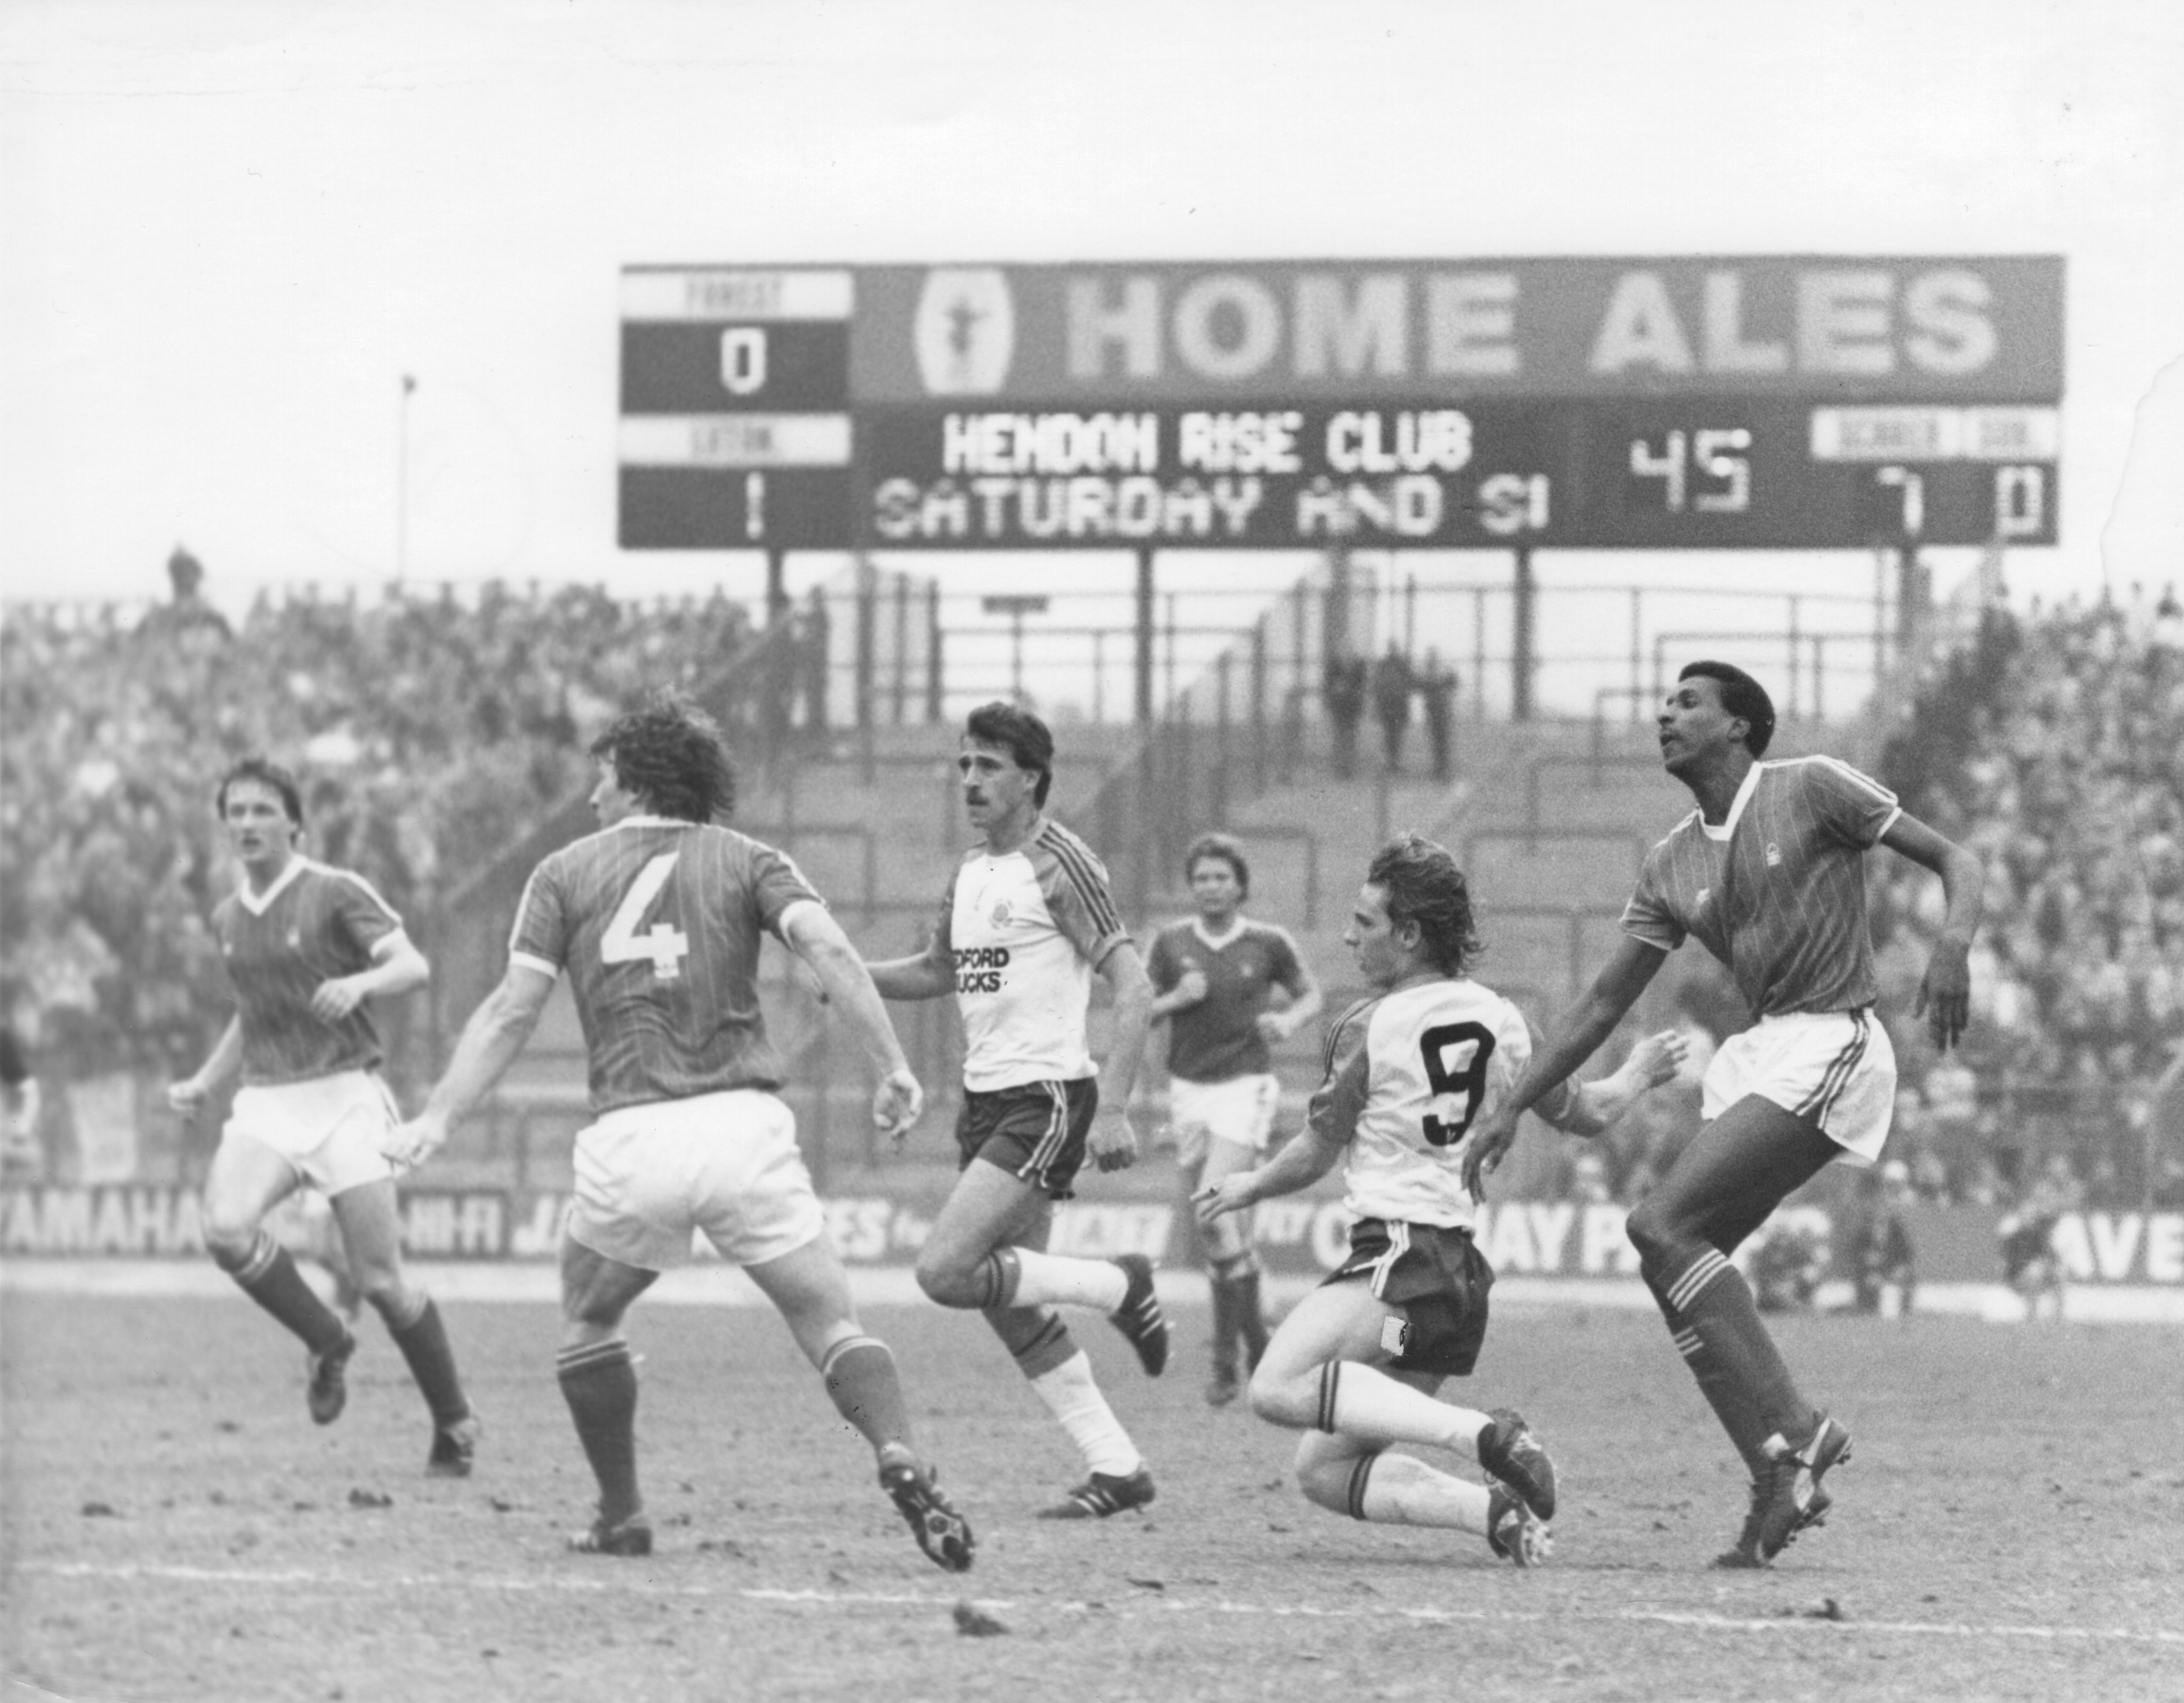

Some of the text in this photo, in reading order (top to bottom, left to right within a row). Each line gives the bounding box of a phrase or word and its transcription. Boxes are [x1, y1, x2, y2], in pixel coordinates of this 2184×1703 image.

[1065, 269, 1998, 379] HOME ALES
[720, 326, 767, 394] 0
[1179, 411, 1303, 474] RISE
[1326, 410, 1473, 472] CLUB
[1630, 428, 1752, 512] 45
[874, 476, 1262, 538] SATURDAY
[1296, 474, 1443, 535] AND
[1877, 465, 1924, 533] 7
[600, 850, 688, 979] 4
[1420, 1020, 1496, 1147] 9
[0, 1189, 206, 1252] AMAHA
